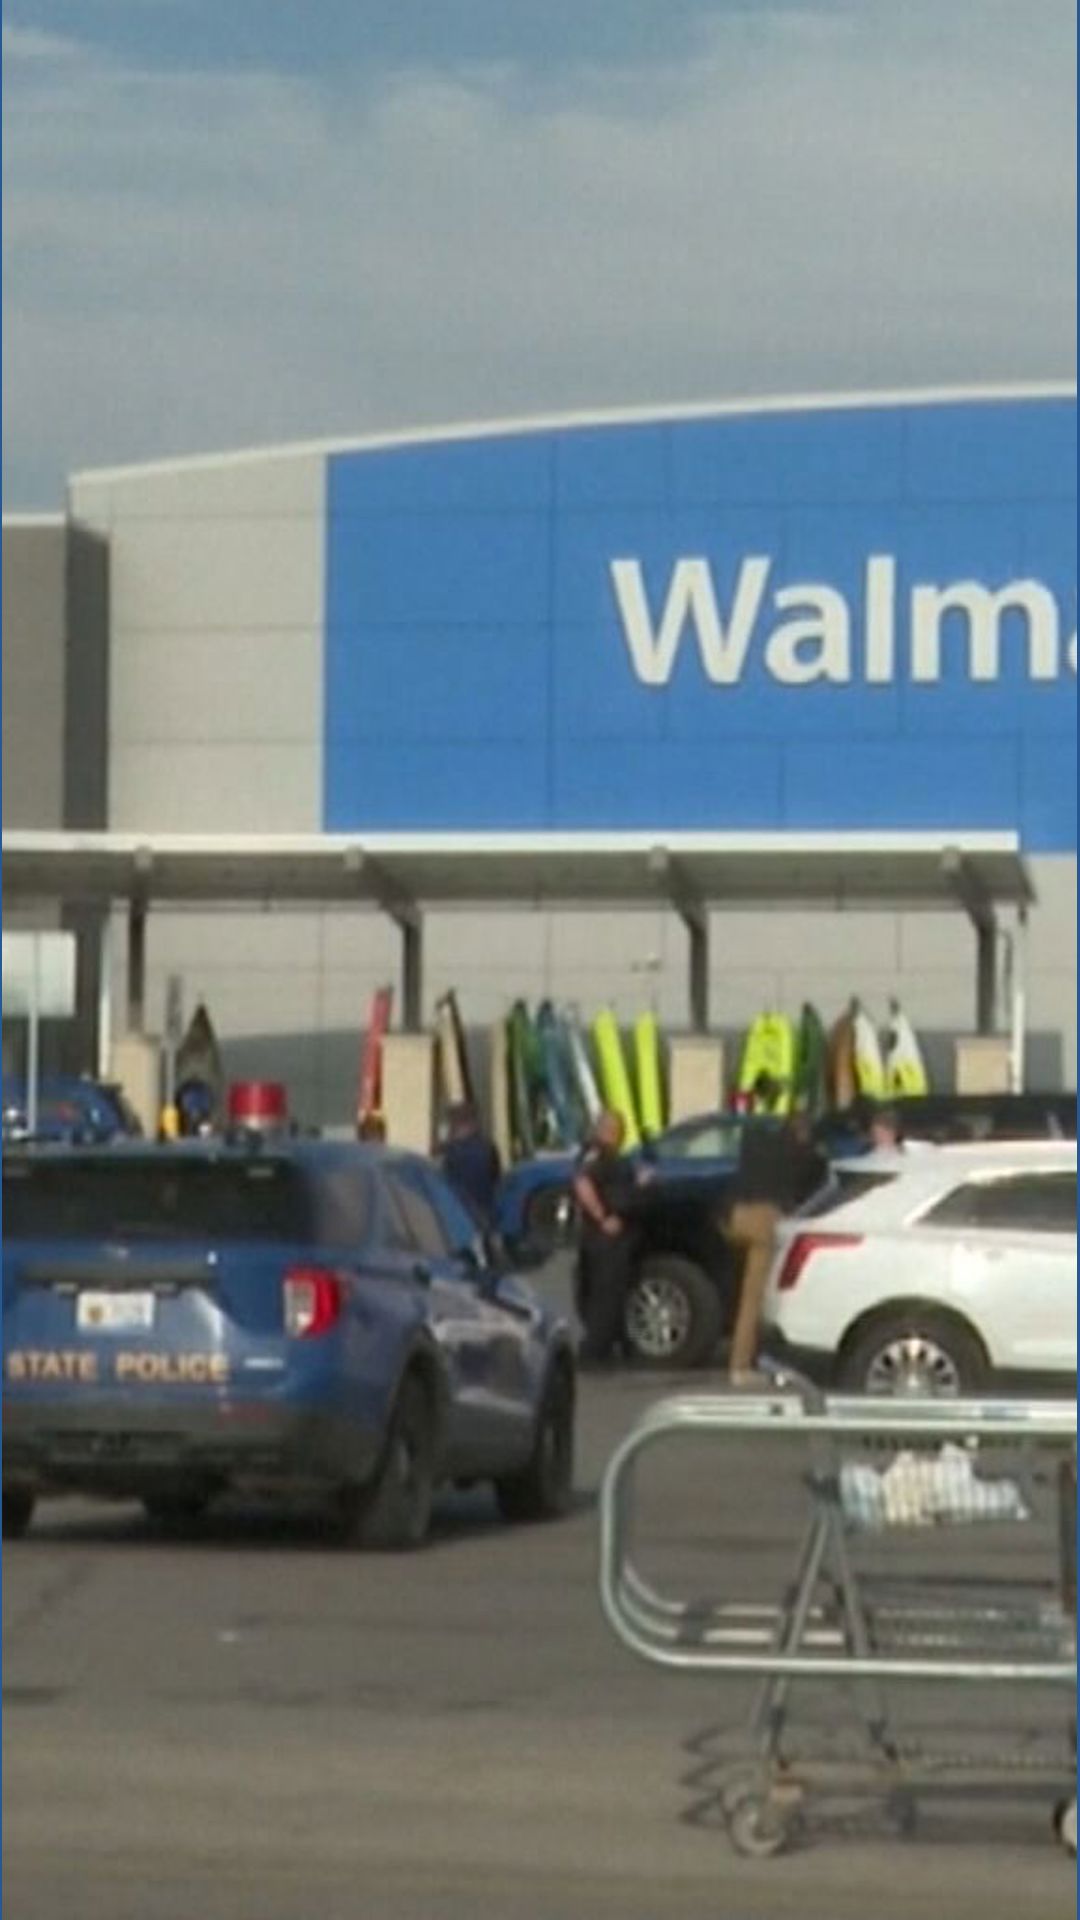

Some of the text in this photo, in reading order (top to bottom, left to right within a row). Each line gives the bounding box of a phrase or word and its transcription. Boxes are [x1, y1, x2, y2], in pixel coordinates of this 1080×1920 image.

[610, 555, 1077, 686] Walm
[7, 1350, 97, 1381] STATE
[115, 1351, 230, 1383] POLICE
